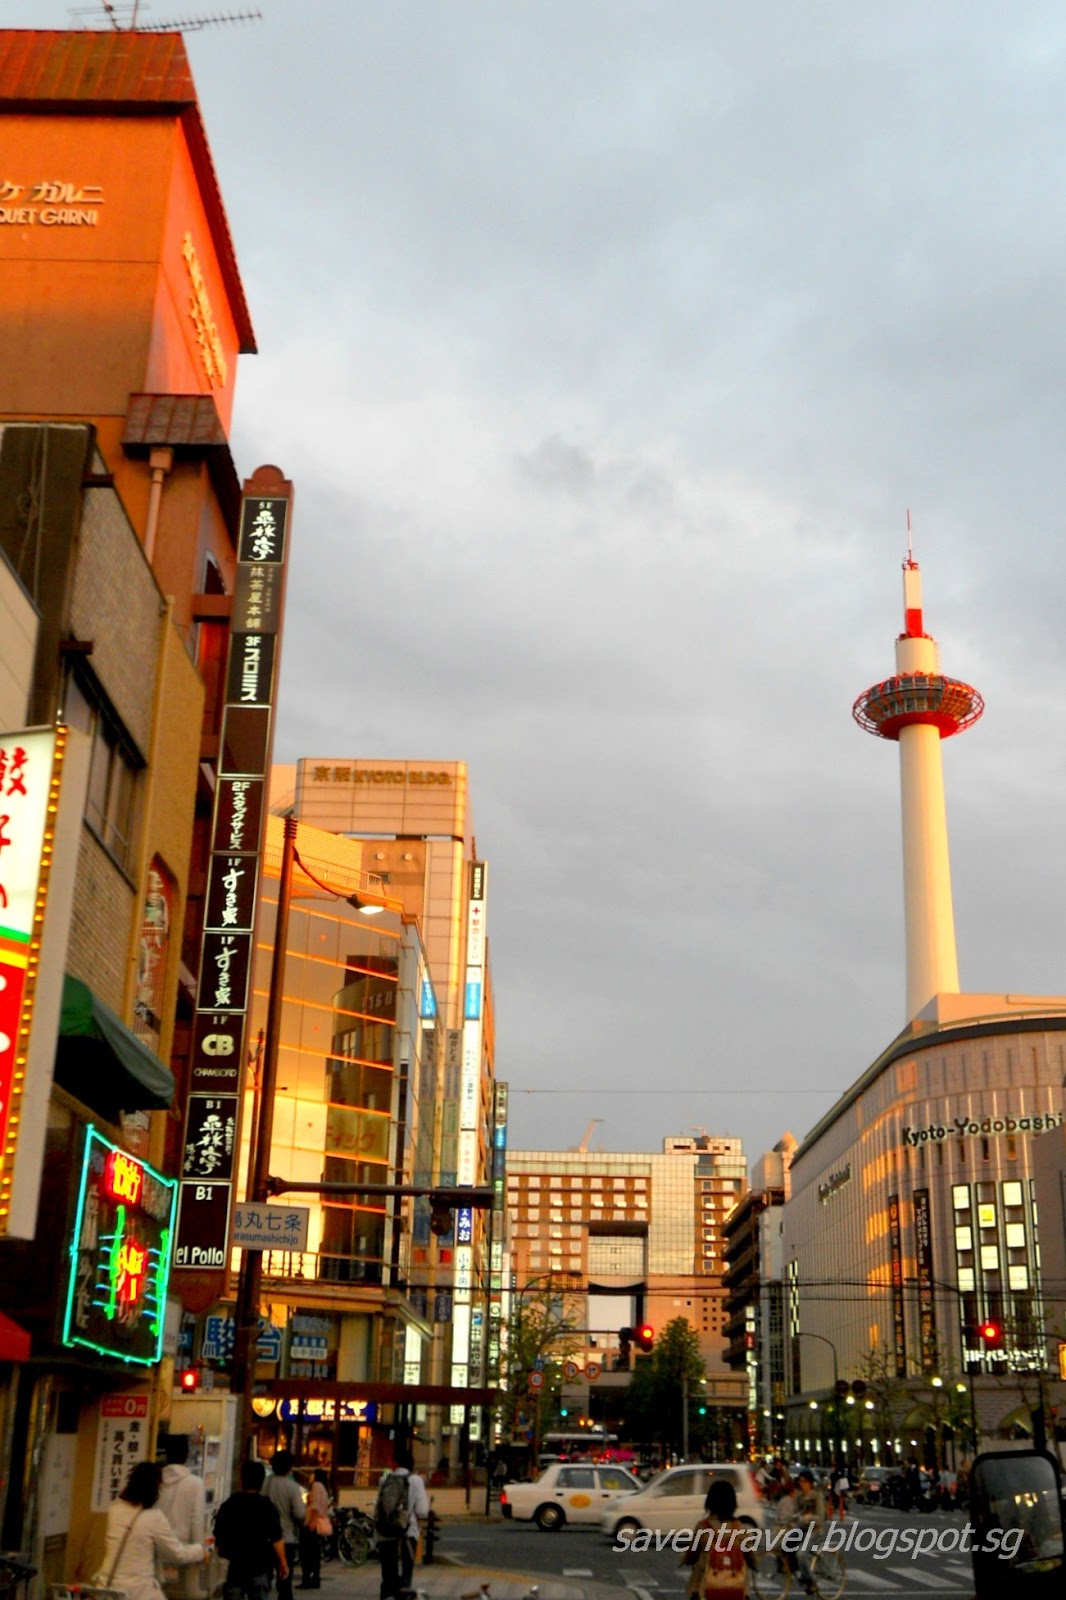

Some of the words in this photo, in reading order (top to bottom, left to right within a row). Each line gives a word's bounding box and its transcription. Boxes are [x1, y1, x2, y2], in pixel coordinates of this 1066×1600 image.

[32, 181, 104, 203] ガルニ
[40, 208, 97, 226] GARNI
[245, 636, 262, 647] 3F
[240, 648, 261, 702] プロミス
[231, 781, 251, 792] 2F
[354, 770, 405, 784] KYOTO
[229, 792, 247, 850] スタッフサービス
[221, 868, 245, 927] すき家
[221, 936, 235, 945] 1F
[214, 947, 238, 1007] すき家
[202, 1034, 234, 1056] CB
[206, 1100, 222, 1110] B1
[902, 1112, 1063, 1147] Kyoto-Yodobashi
[195, 1186, 213, 1201] B1
[176, 1246, 188, 1264] el
[191, 1247, 224, 1265] Pollo
